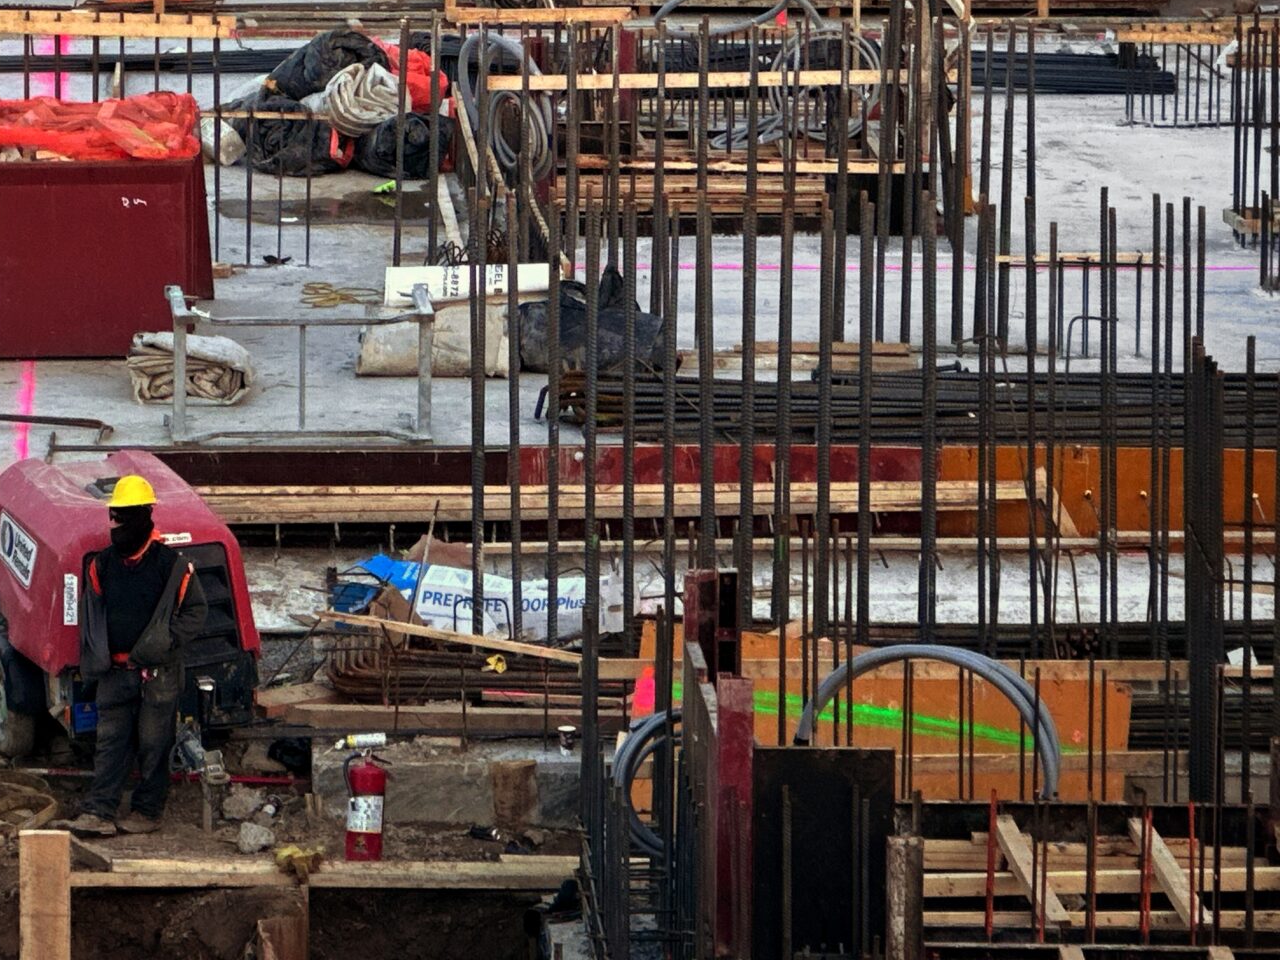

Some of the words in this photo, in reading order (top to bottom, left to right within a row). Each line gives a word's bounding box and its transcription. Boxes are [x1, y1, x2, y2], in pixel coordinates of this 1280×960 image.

[14, 531, 34, 562] United
[422, 590, 502, 612] PREPRFE
[514, 597, 549, 612] 00R
[557, 596, 586, 610] Plus
